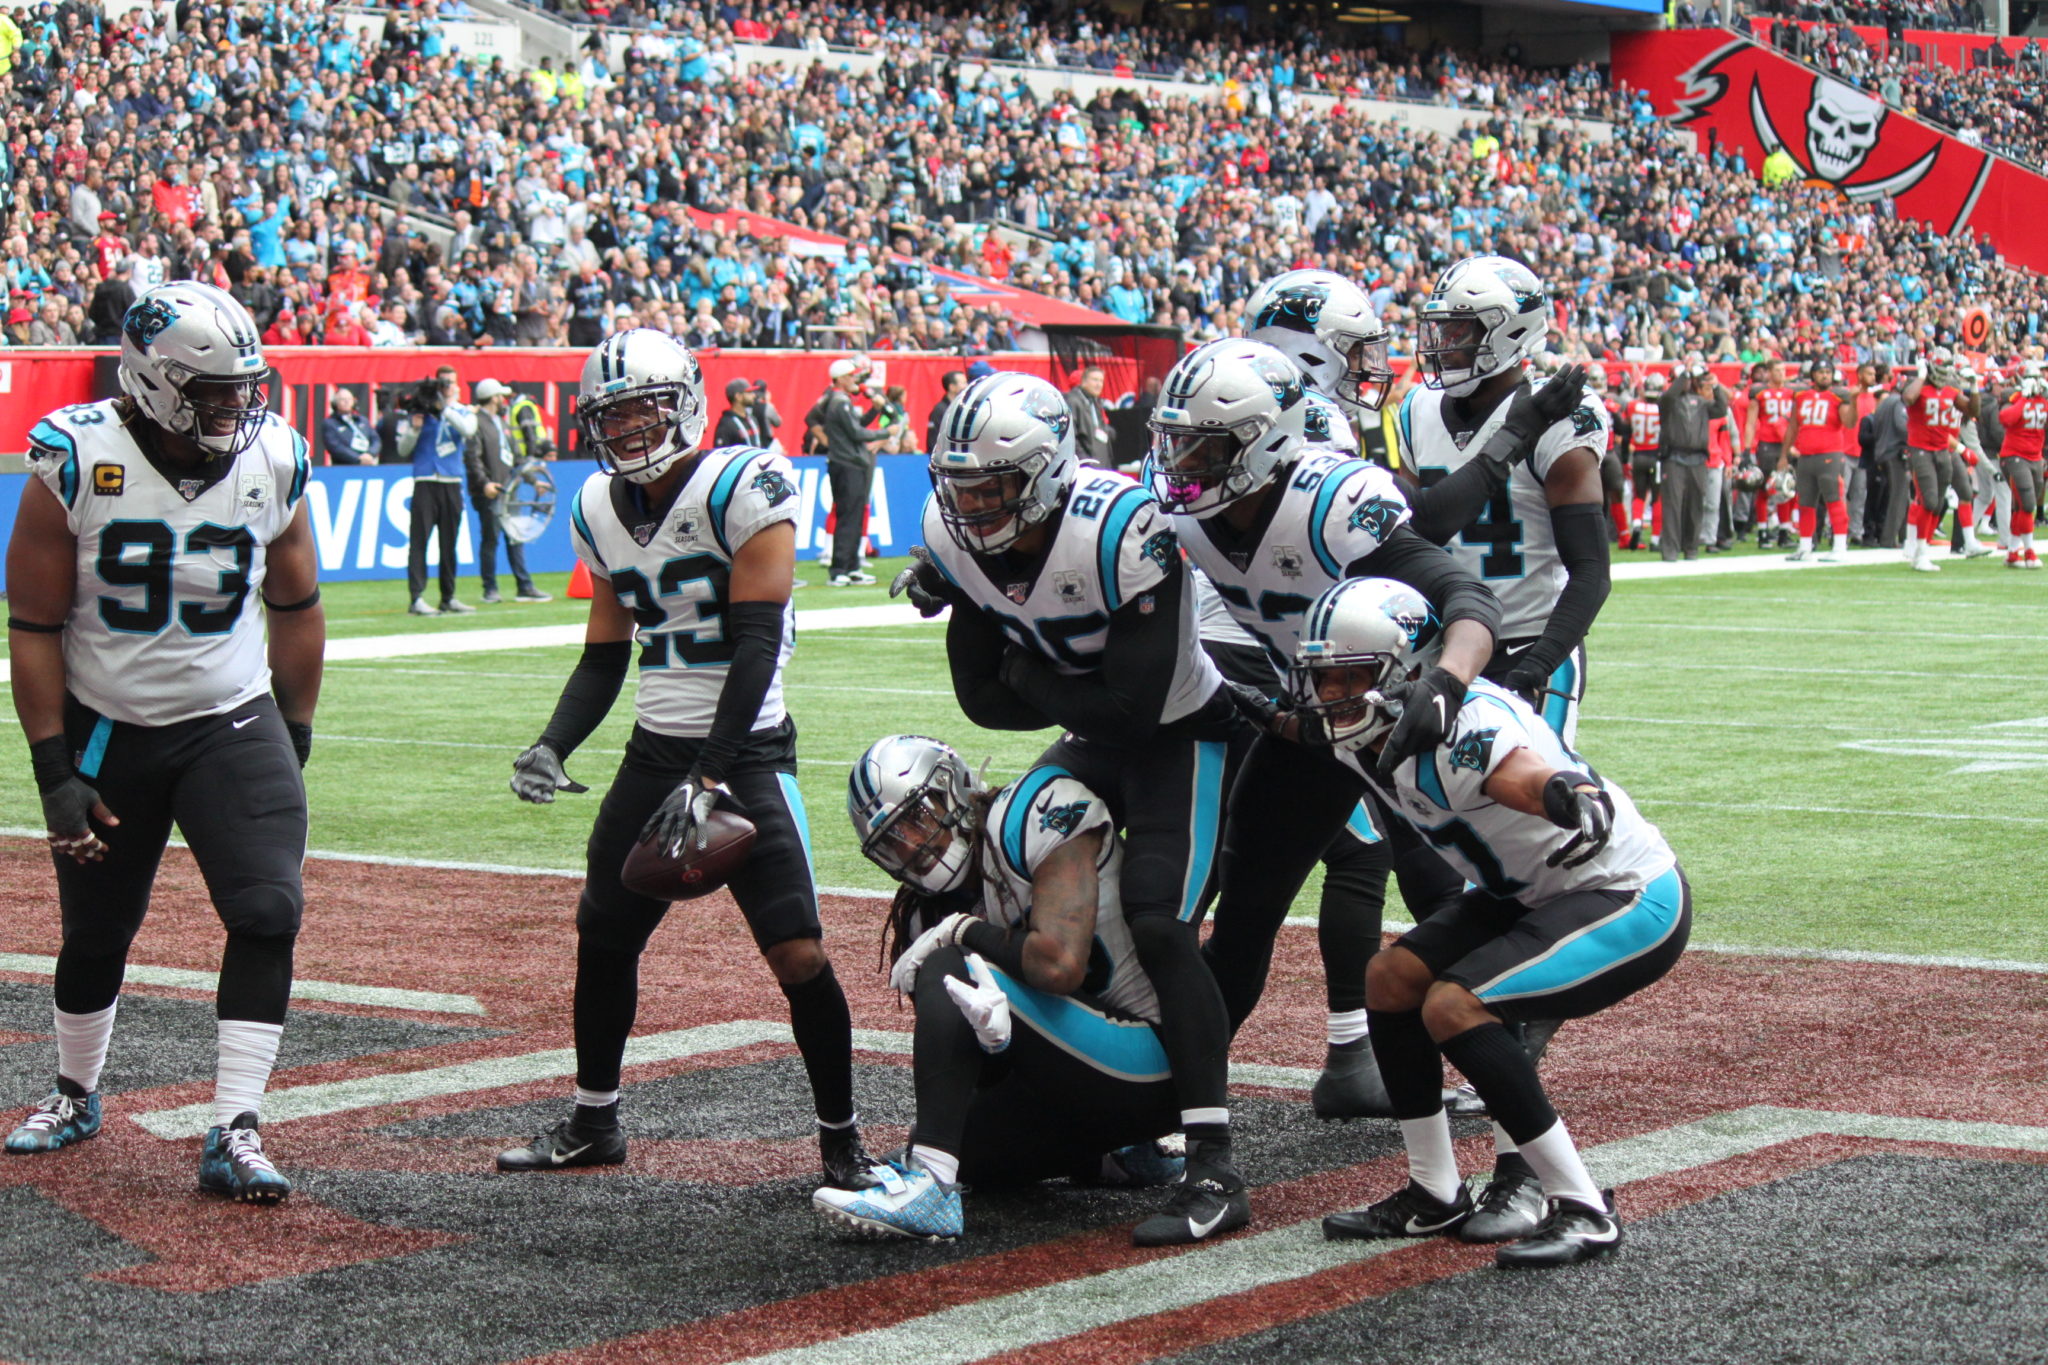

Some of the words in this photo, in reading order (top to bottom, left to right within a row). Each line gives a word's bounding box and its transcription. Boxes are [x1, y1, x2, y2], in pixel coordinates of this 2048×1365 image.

[474, 32, 494, 46] 121
[95, 464, 123, 488] C
[241, 474, 268, 498] 25
[1290, 455, 1341, 494] 53
[243, 501, 265, 509] SEASONS
[673, 507, 699, 533] 25
[674, 535, 699, 543] SEASONS
[96, 519, 257, 638] 93
[610, 551, 735, 670] 23
